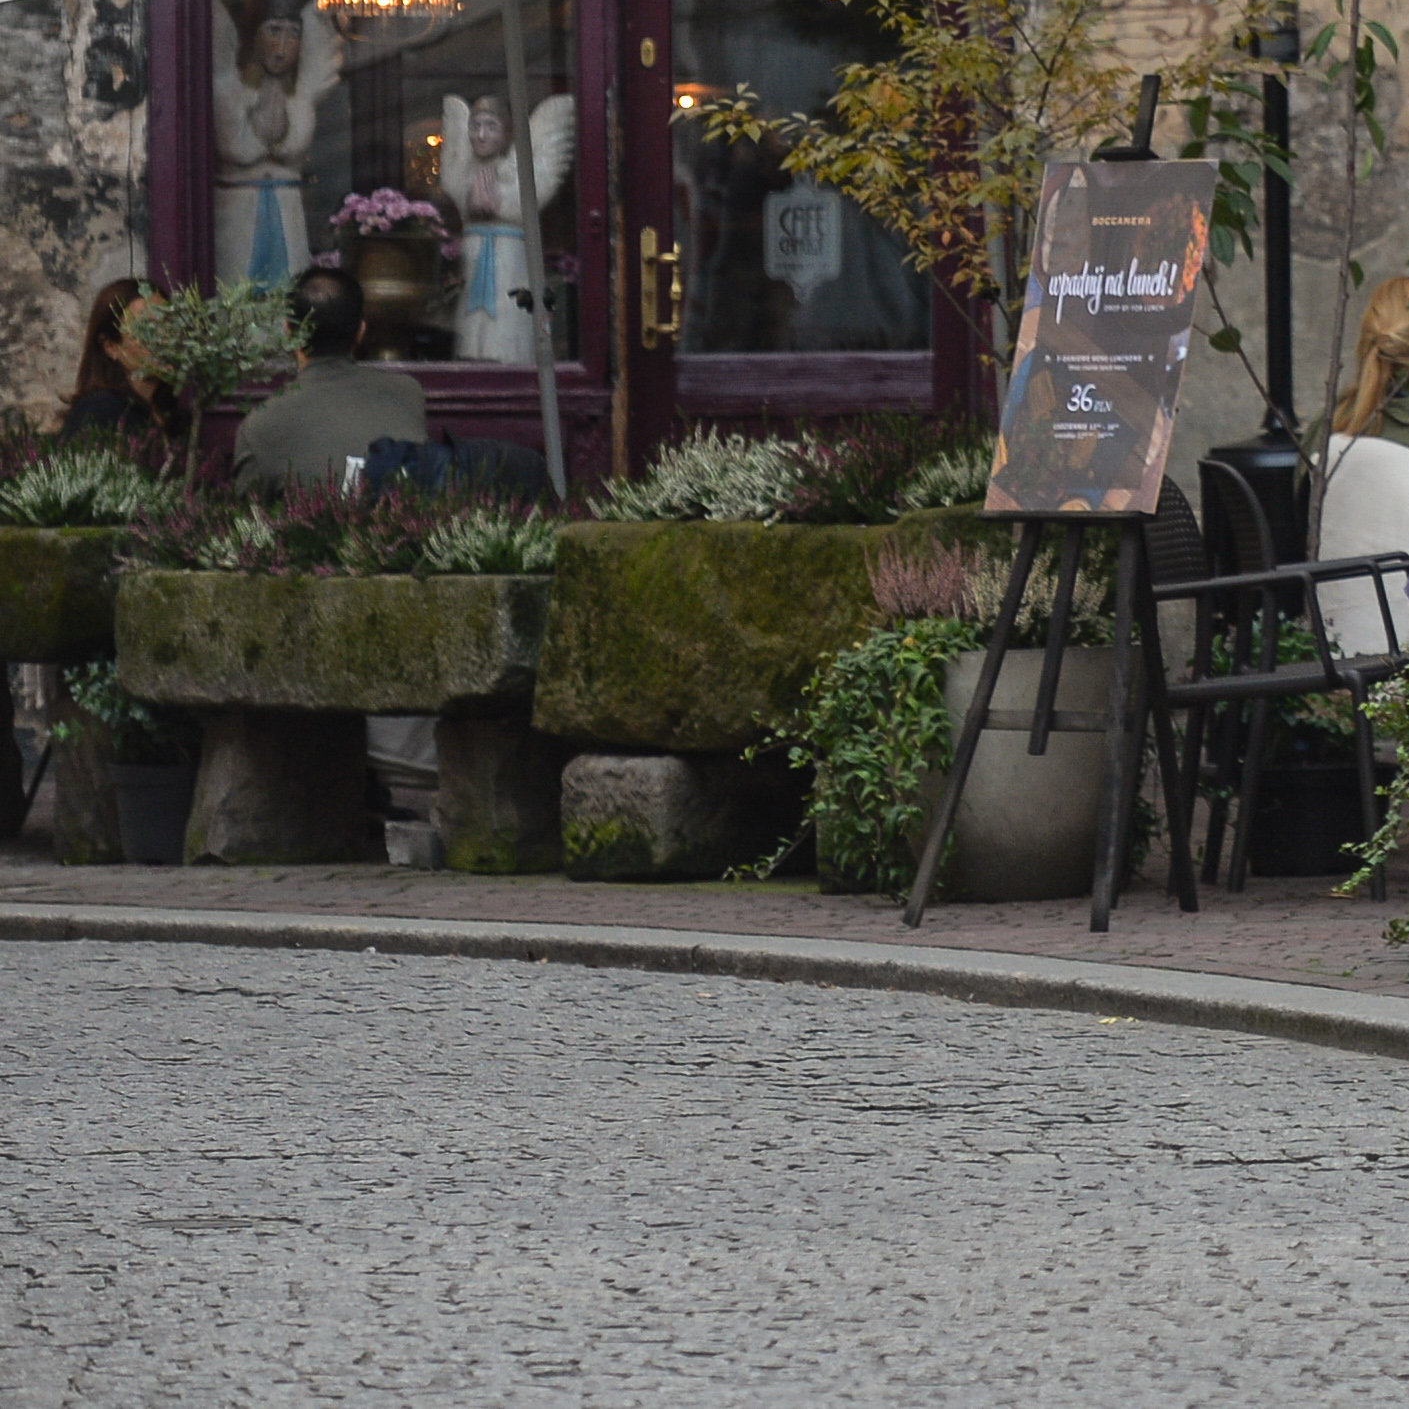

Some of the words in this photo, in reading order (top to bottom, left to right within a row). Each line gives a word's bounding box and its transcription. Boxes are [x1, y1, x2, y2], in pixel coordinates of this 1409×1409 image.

[1091, 216, 1152, 226] BOCCANERA
[1104, 269, 1125, 297] na
[1126, 256, 1178, 297] lunch!
[1066, 383, 1096, 412] 36
